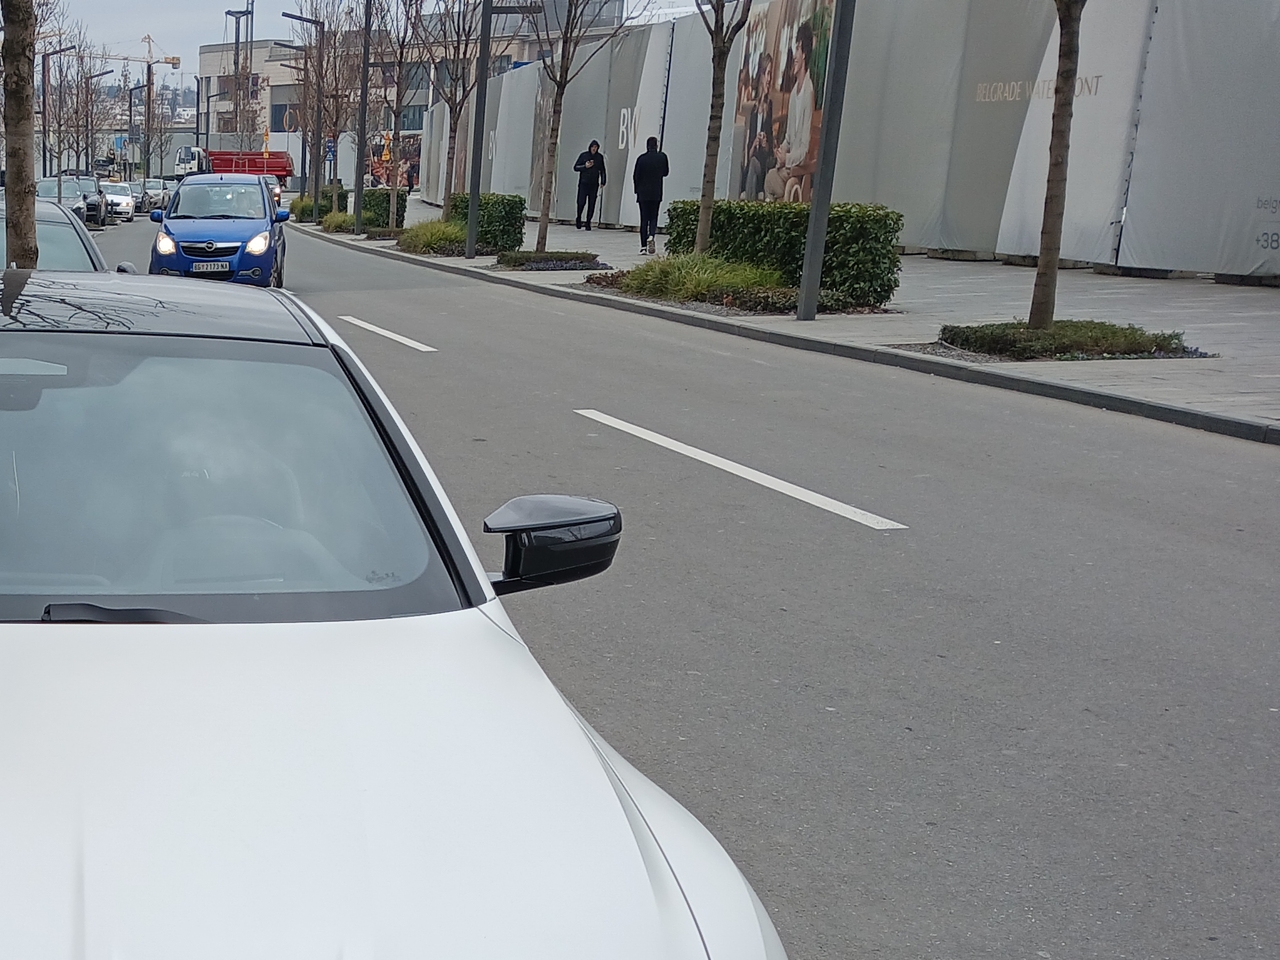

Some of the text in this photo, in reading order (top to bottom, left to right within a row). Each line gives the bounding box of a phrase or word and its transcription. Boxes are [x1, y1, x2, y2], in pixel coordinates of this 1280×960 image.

[976, 75, 1103, 102] BELGRADE WATEONT
[1257, 195, 1280, 214] belg
